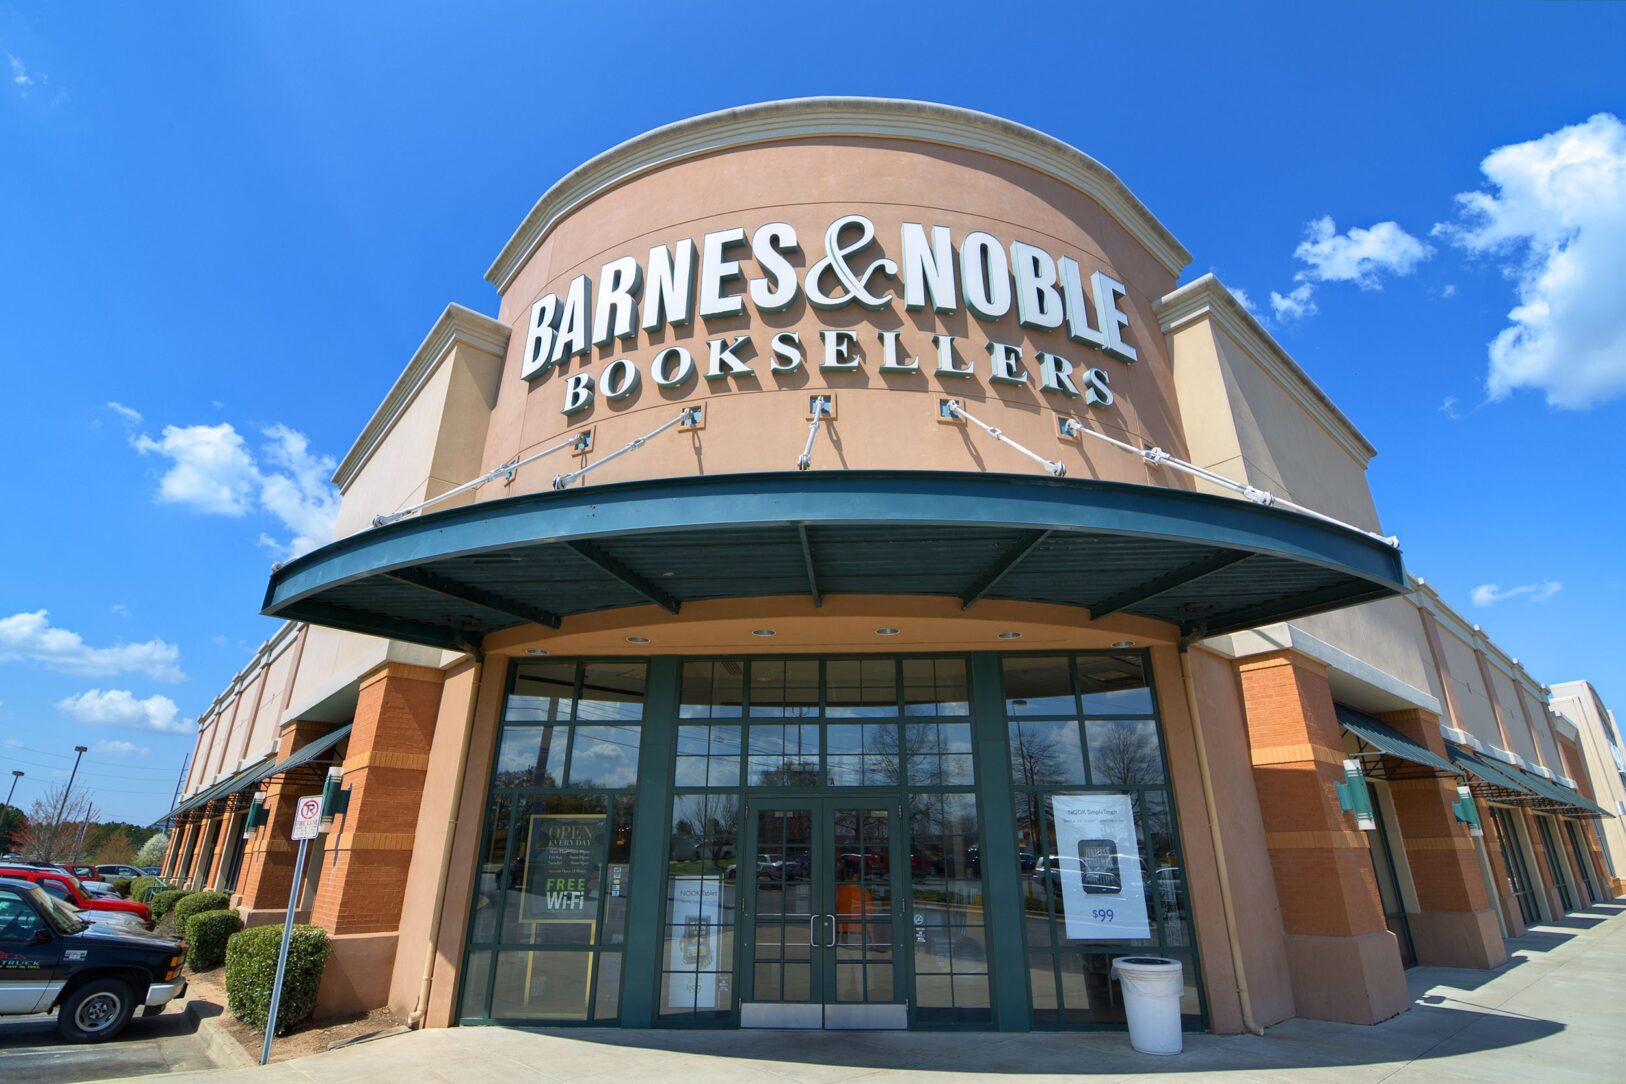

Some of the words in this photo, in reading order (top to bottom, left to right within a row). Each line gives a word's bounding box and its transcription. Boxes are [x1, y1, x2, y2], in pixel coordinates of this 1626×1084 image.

[561, 328, 1115, 416] BOOKSELLERS
[549, 825, 593, 840] OPEN
[546, 878, 586, 890] FREE
[546, 891, 584, 910] Wi-Fi
[1092, 908, 1114, 922] $99
